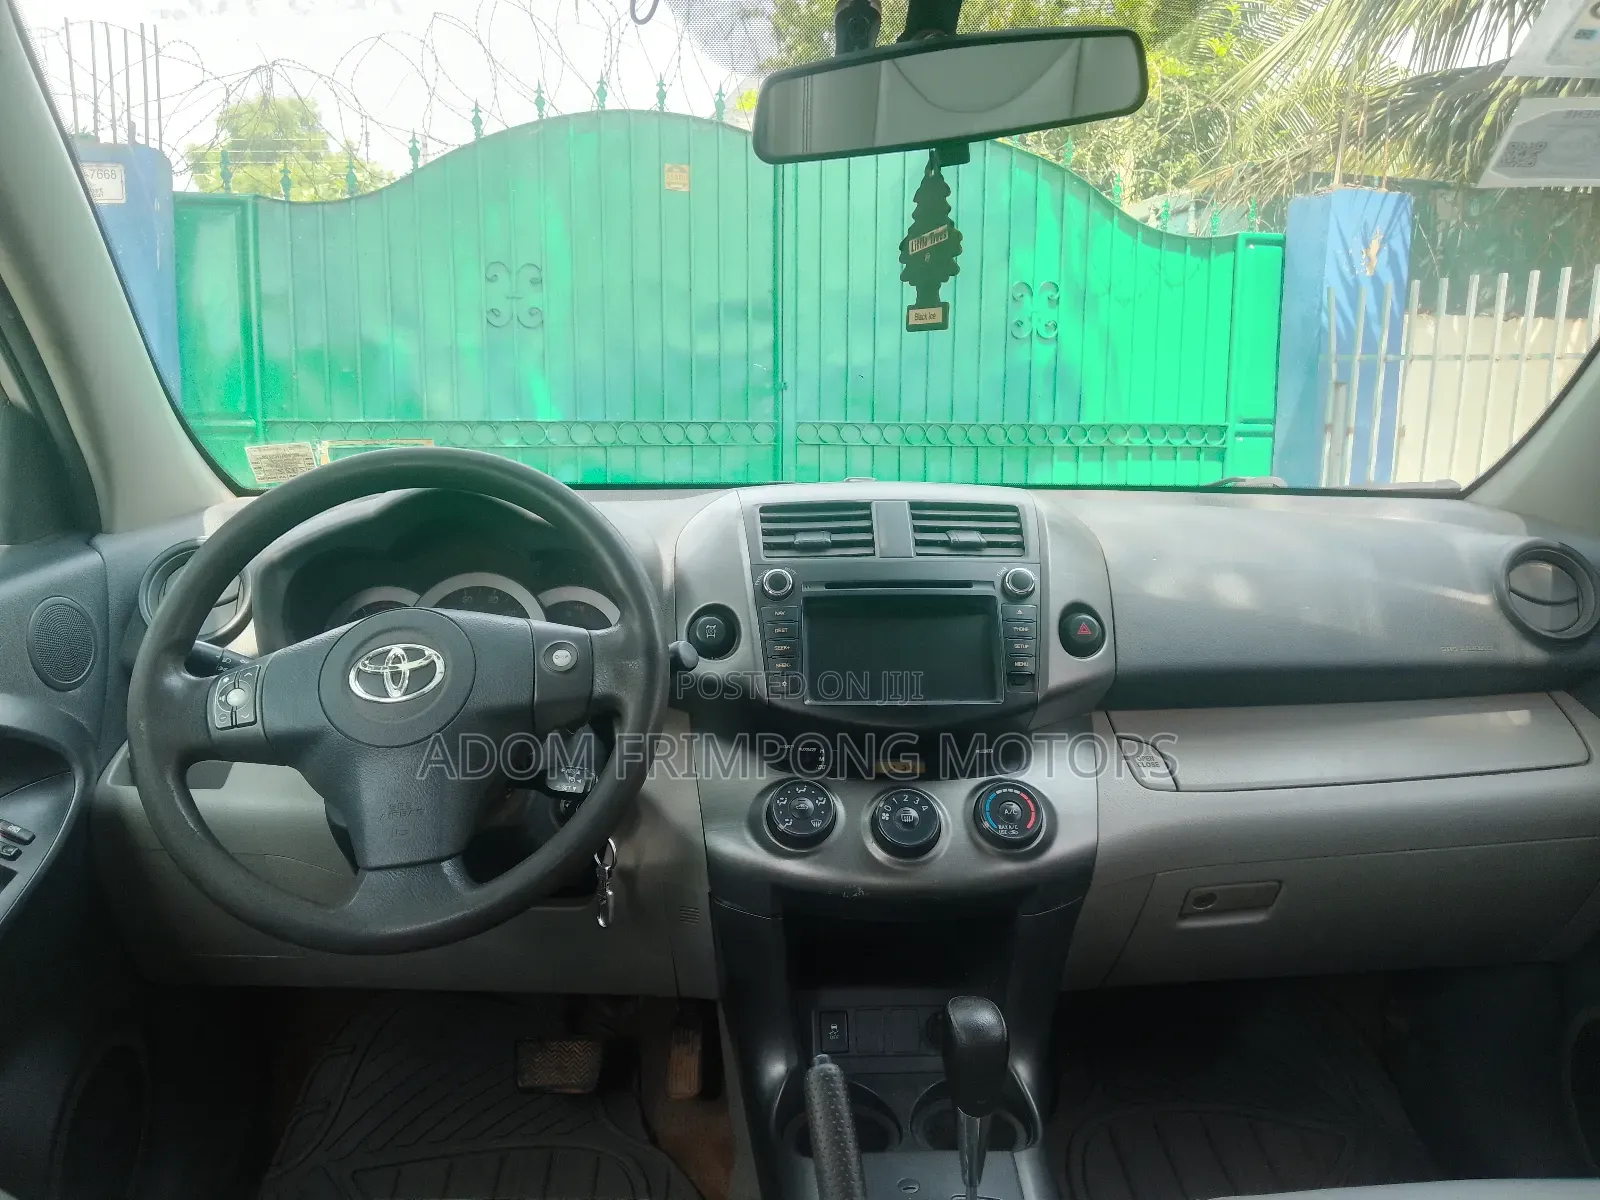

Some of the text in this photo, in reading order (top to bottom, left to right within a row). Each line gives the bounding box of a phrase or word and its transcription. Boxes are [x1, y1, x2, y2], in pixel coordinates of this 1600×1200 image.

[914, 312, 928, 321] Black
[902, 794, 909, 802] 2
[913, 796, 920, 805] 3
